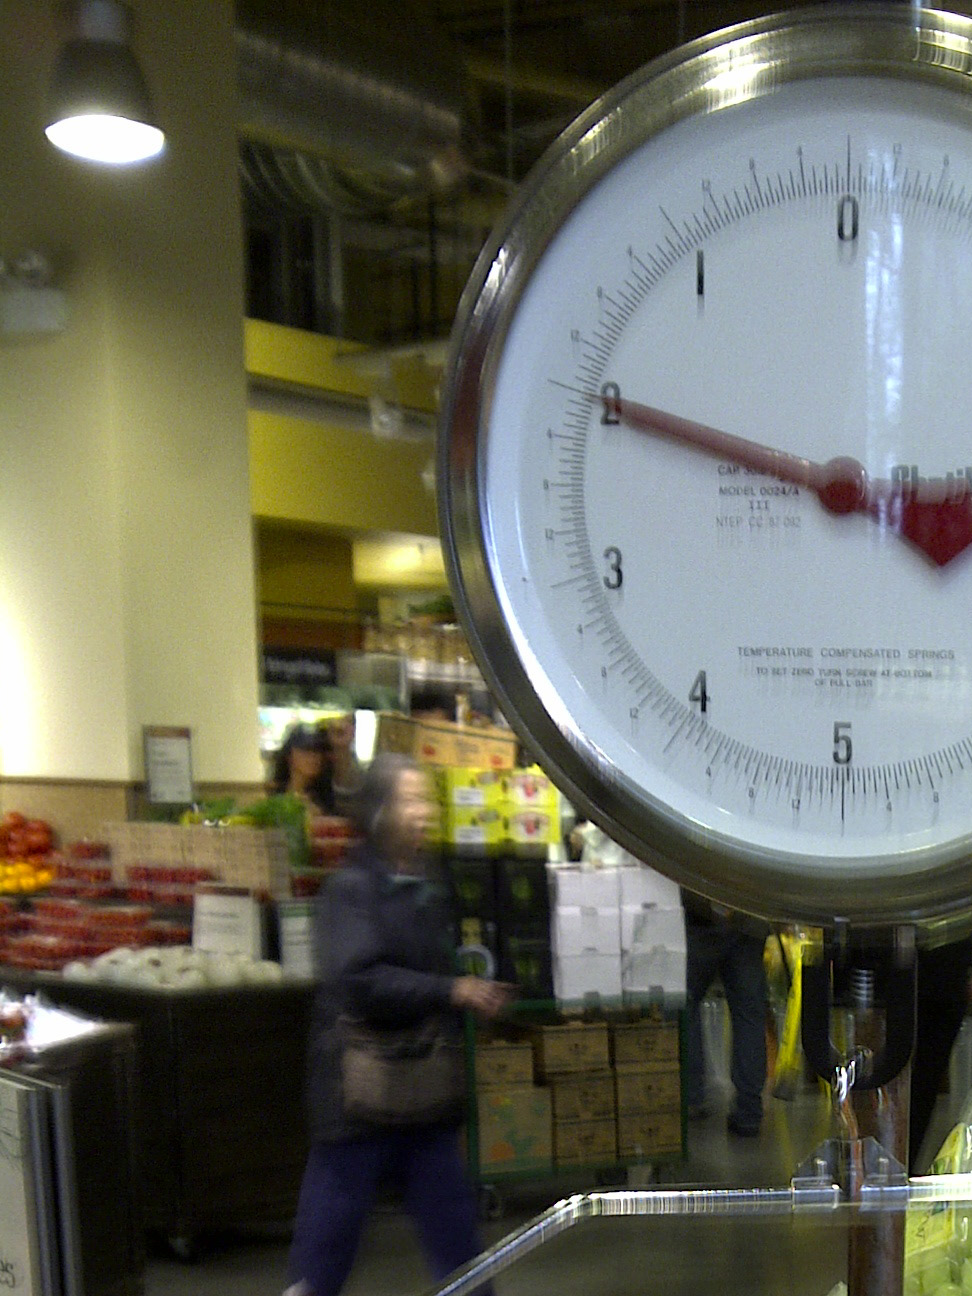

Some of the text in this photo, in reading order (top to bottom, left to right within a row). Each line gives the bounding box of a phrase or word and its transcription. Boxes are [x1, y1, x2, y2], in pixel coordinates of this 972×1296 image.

[837, 194, 859, 240] 0
[600, 381, 622, 425] 2
[718, 486, 756, 496] MODEL
[603, 546, 623, 589] 3
[738, 646, 955, 660] TEMPERATURE COMPENSATED SPRINGS
[756, 667, 768, 675] TO
[819, 667, 842, 677] TURN
[688, 670, 711, 713] 4
[832, 721, 853, 765] 5
